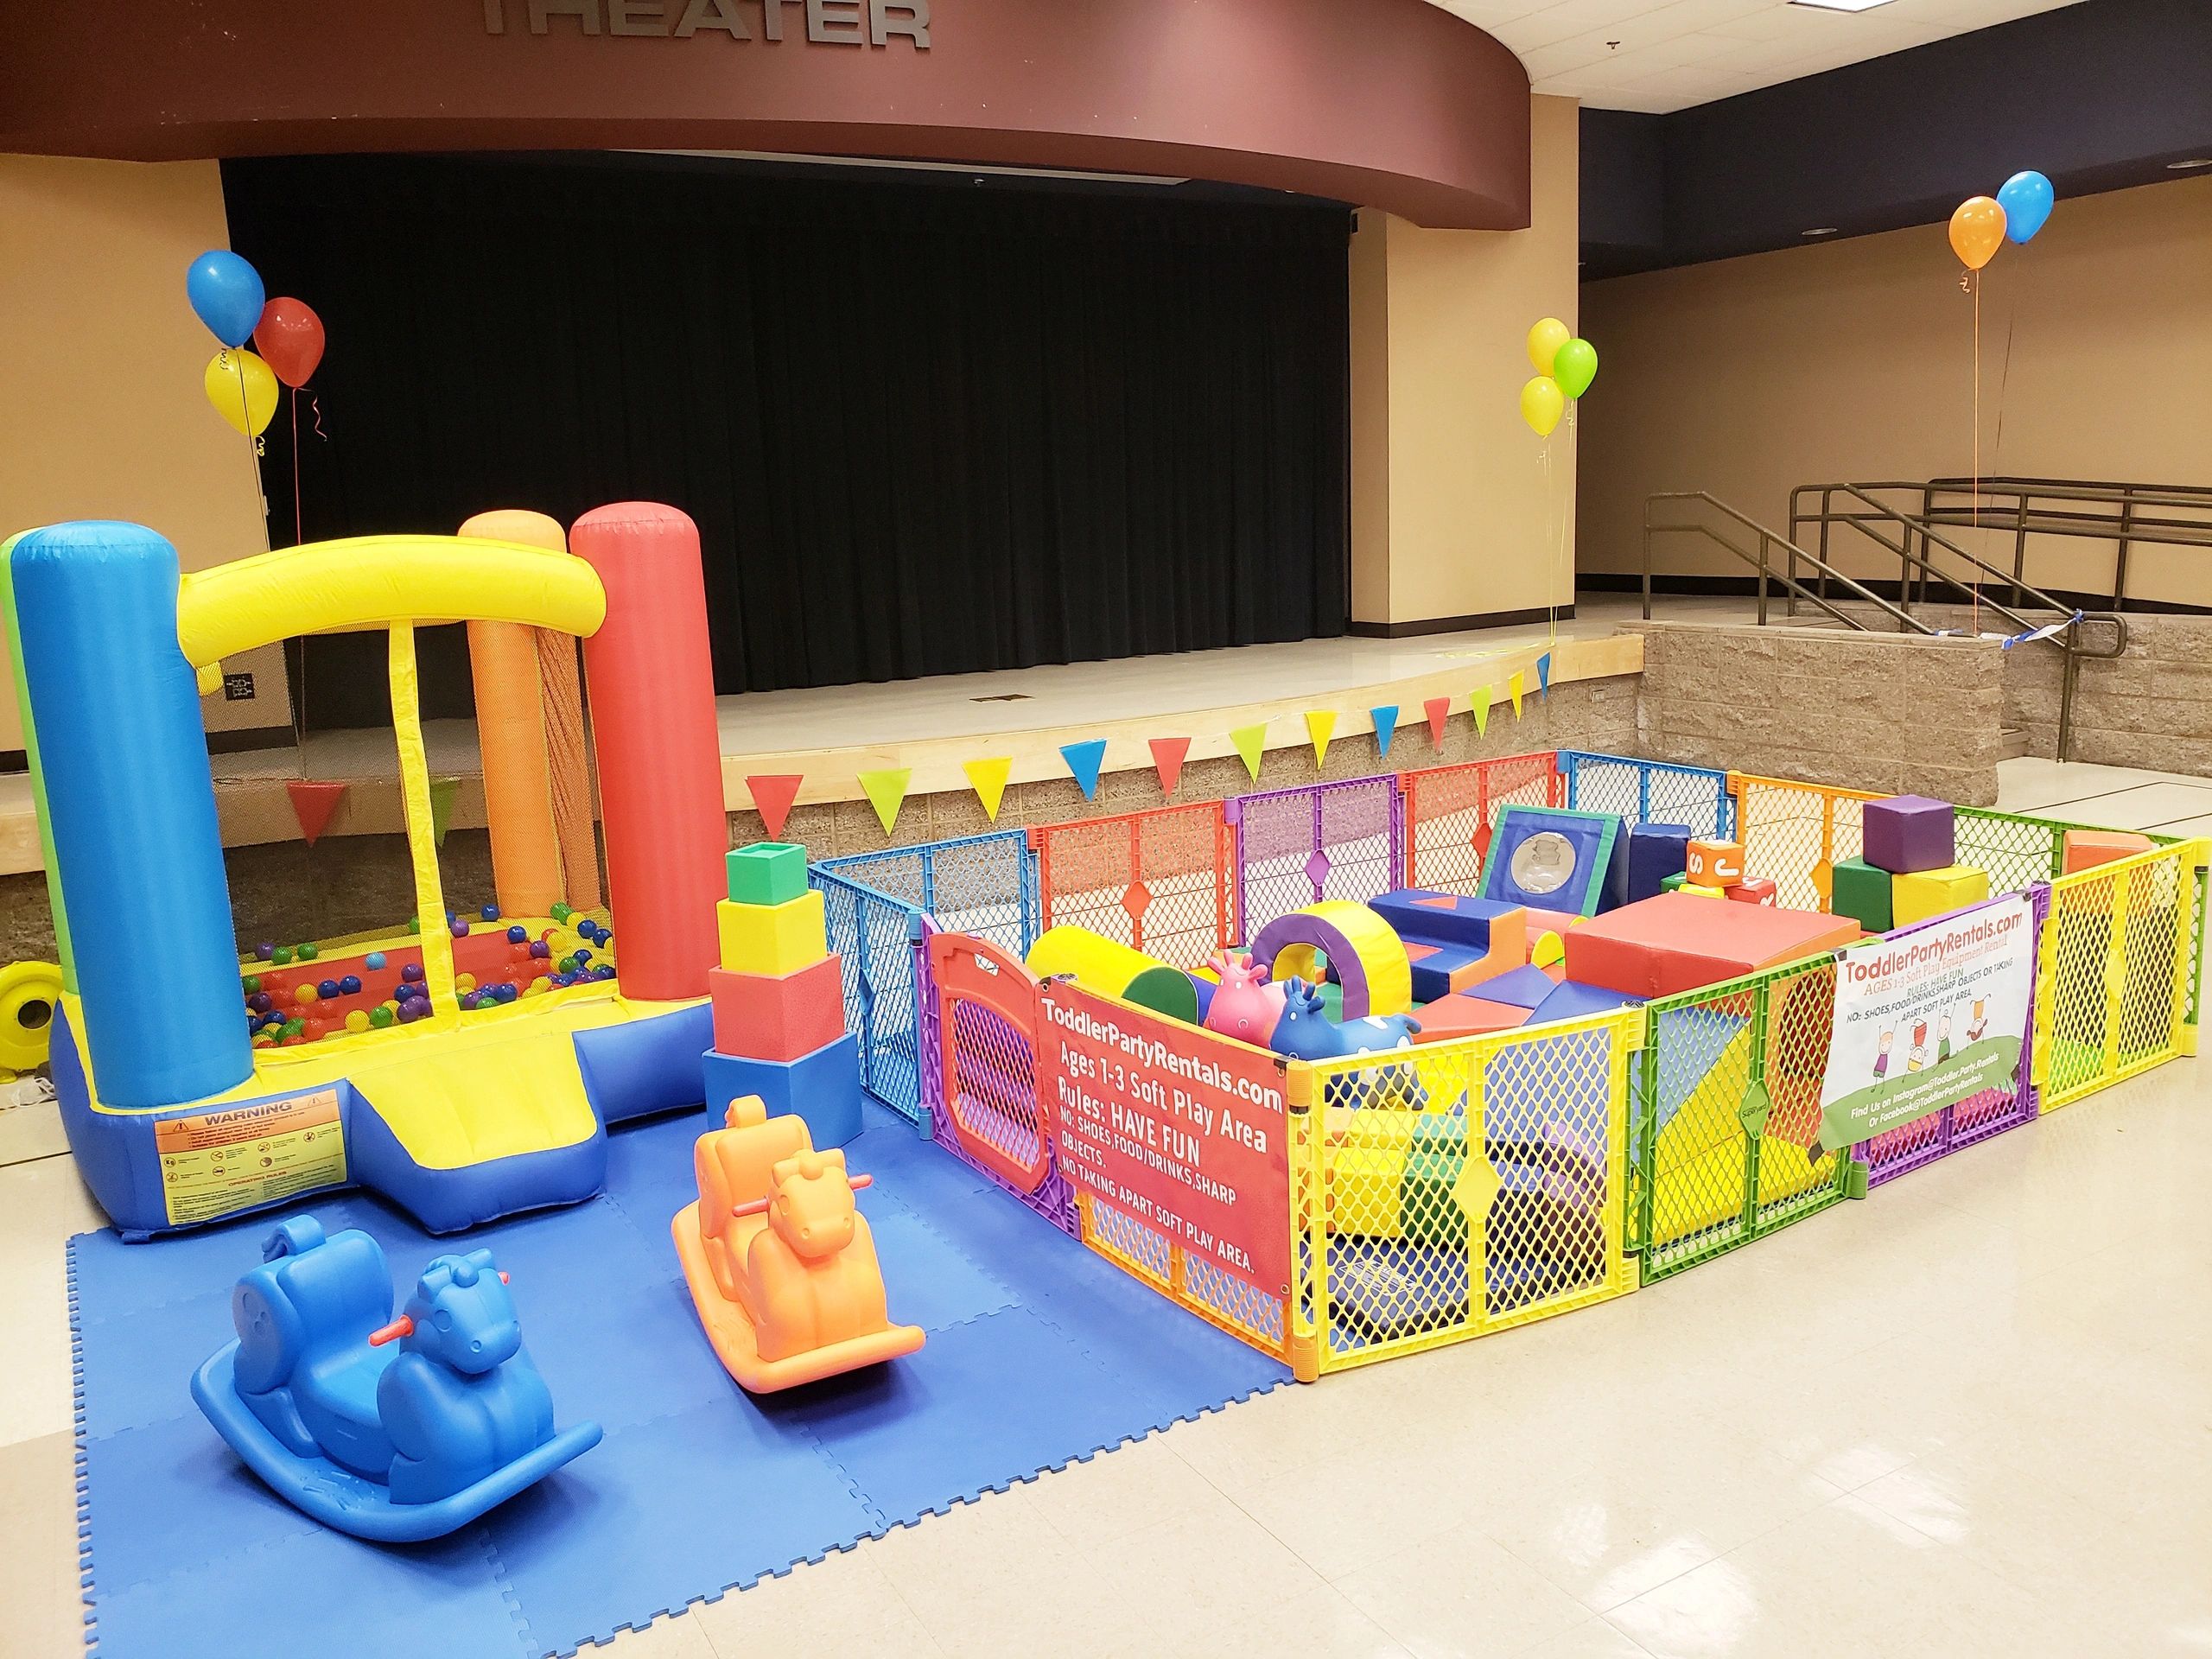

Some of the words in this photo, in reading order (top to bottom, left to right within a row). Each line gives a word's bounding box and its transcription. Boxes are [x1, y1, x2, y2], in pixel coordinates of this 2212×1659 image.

[1846, 912, 2023, 983] ToddlerPartyRentals.com
[1864, 978, 1892, 996] AGES
[1906, 967, 1922, 984] Soft
[1923, 962, 1941, 978] Play
[1942, 946, 1984, 969] Equipment
[1847, 1012, 1862, 1024] NO:
[1983, 966, 1993, 977] OR
[1930, 973, 1948, 988] HAVE
[1948, 968, 1964, 982] FUN
[1901, 1007, 1922, 1023] APART
[1923, 1000, 1938, 1014] SOFT
[1939, 995, 1955, 1008] PLAY
[1040, 997, 1284, 1115] ToddlerPartyRentals.com
[205, 1102, 292, 1126] WARNING
[1058, 1075, 1106, 1123] Rules:
[1110, 1102, 1156, 1147] HAVE
[1162, 1124, 1200, 1167] FUN
[1059, 1105, 1076, 1129] NO:
[1060, 1040, 1096, 1078] Ages
[1099, 1057, 1125, 1092] 1-3
[1130, 1071, 1168, 1111] Soft
[1173, 1089, 1214, 1137] Play
[1220, 1109, 1268, 1154] Area
[1851, 1103, 1868, 1120] Find
[1871, 1101, 1881, 1113] Us
[1882, 1098, 1891, 1109] on
[1869, 1117, 1878, 1128] Or
[1879, 1073, 1983, 1123] Facebook@ToddlerPartyRentals
[1061, 1129, 1107, 1168] OBJECTS.
[1061, 1154, 1076, 1176] NO
[1077, 1165, 1116, 1198] TAKING
[1118, 1185, 1153, 1218] APART
[1155, 1205, 1184, 1233] SOFT
[1185, 1222, 1214, 1253] PLAY
[1217, 1238, 1255, 1274] AREA.
